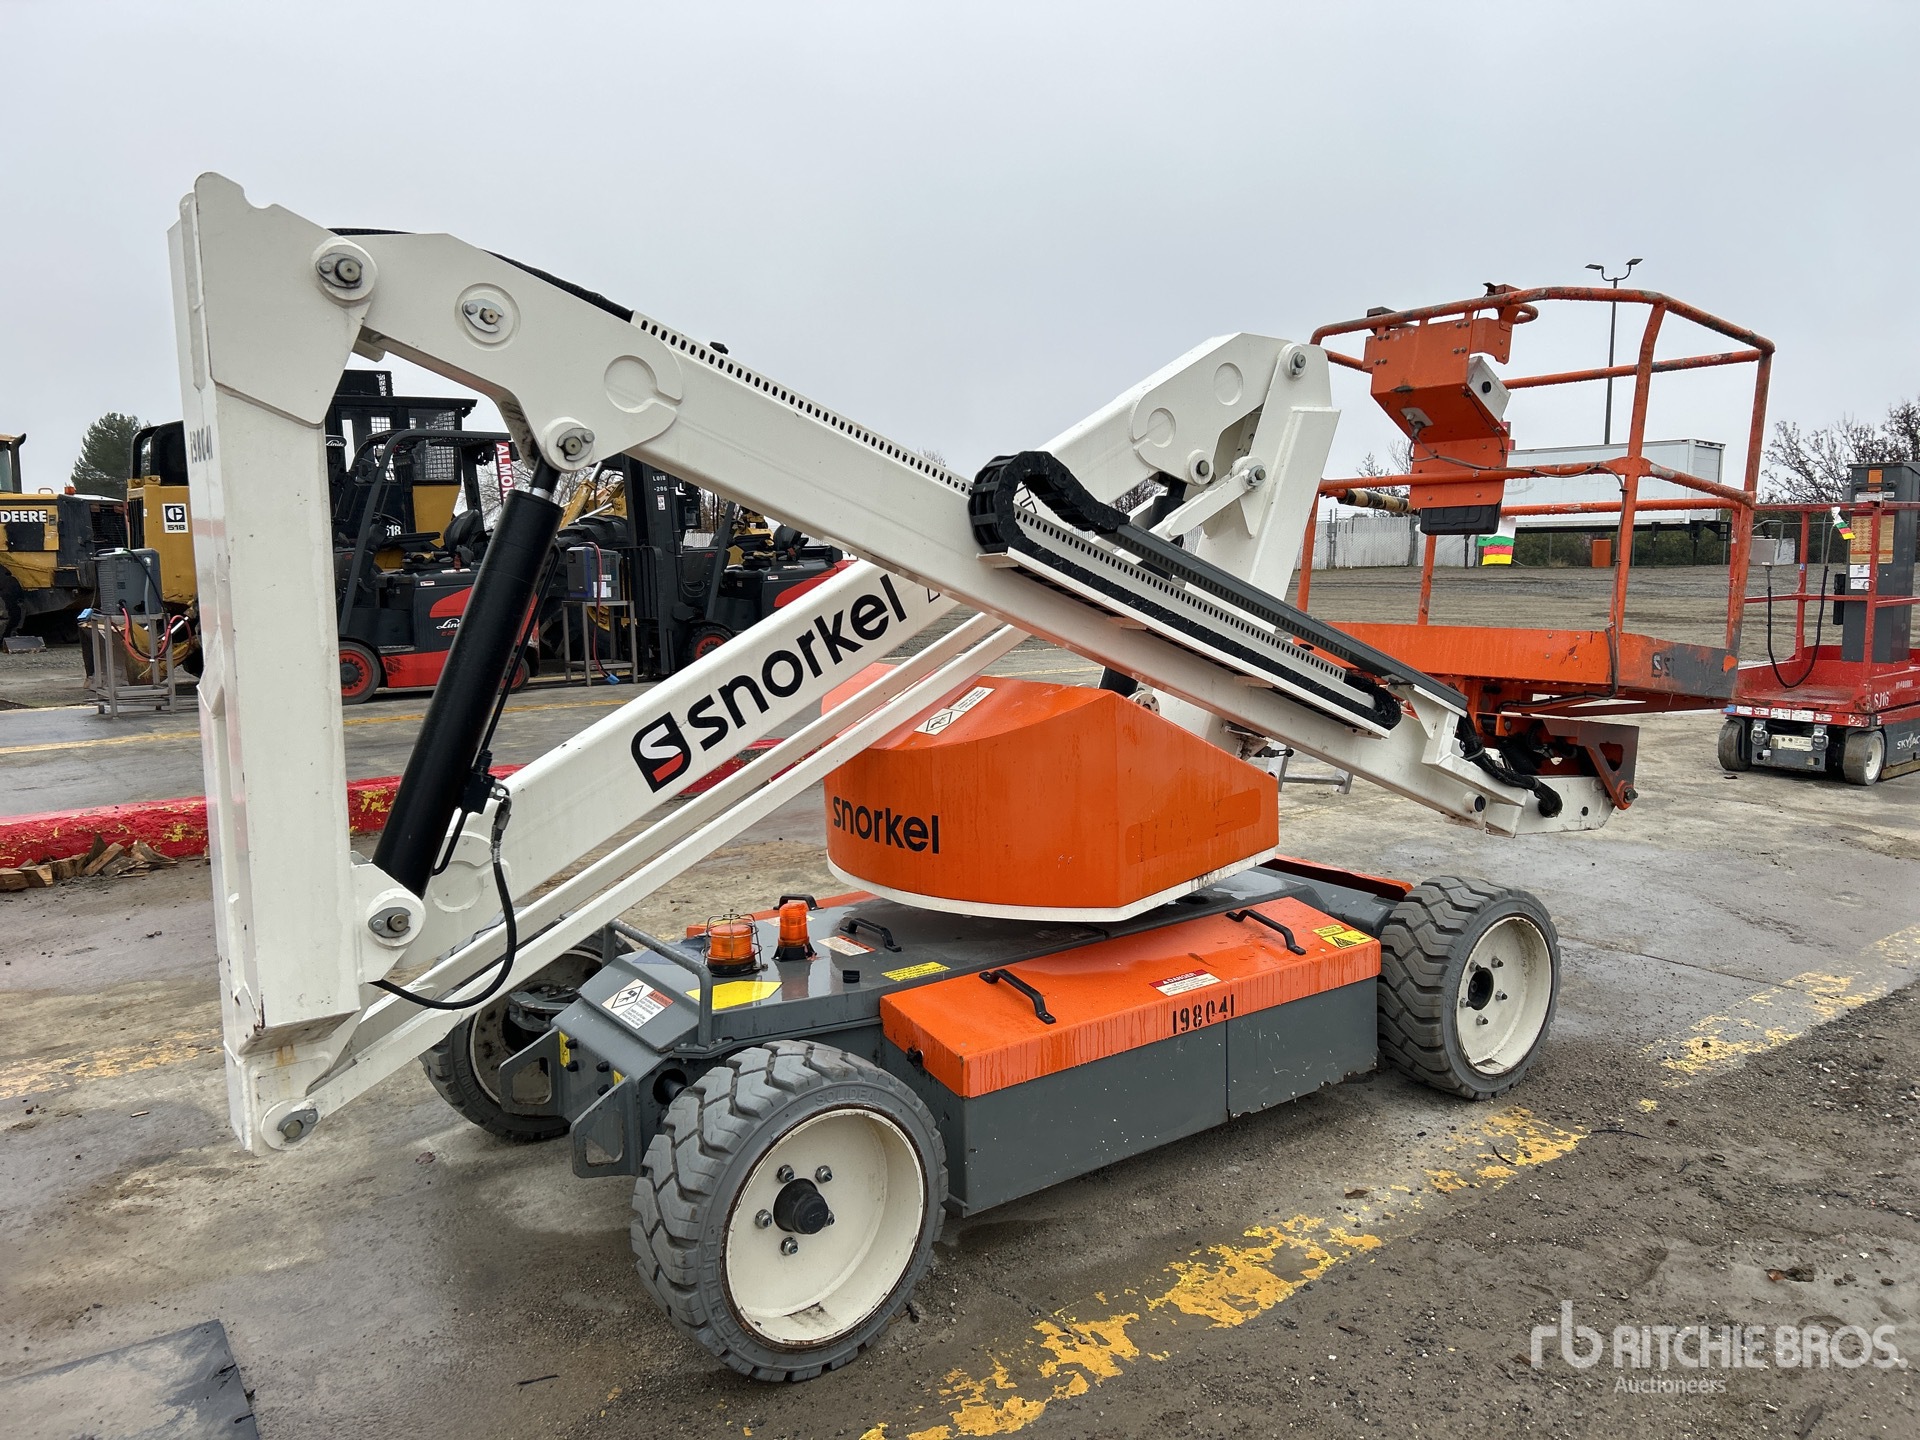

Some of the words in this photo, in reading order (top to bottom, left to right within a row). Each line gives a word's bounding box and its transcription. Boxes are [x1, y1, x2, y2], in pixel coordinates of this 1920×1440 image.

[0, 511, 47, 523] DEERE
[687, 573, 907, 752] snorkel
[833, 796, 940, 854] snorkel
[1172, 994, 1235, 1034] 198041
[815, 1087, 883, 1107] SOLIDEAL
